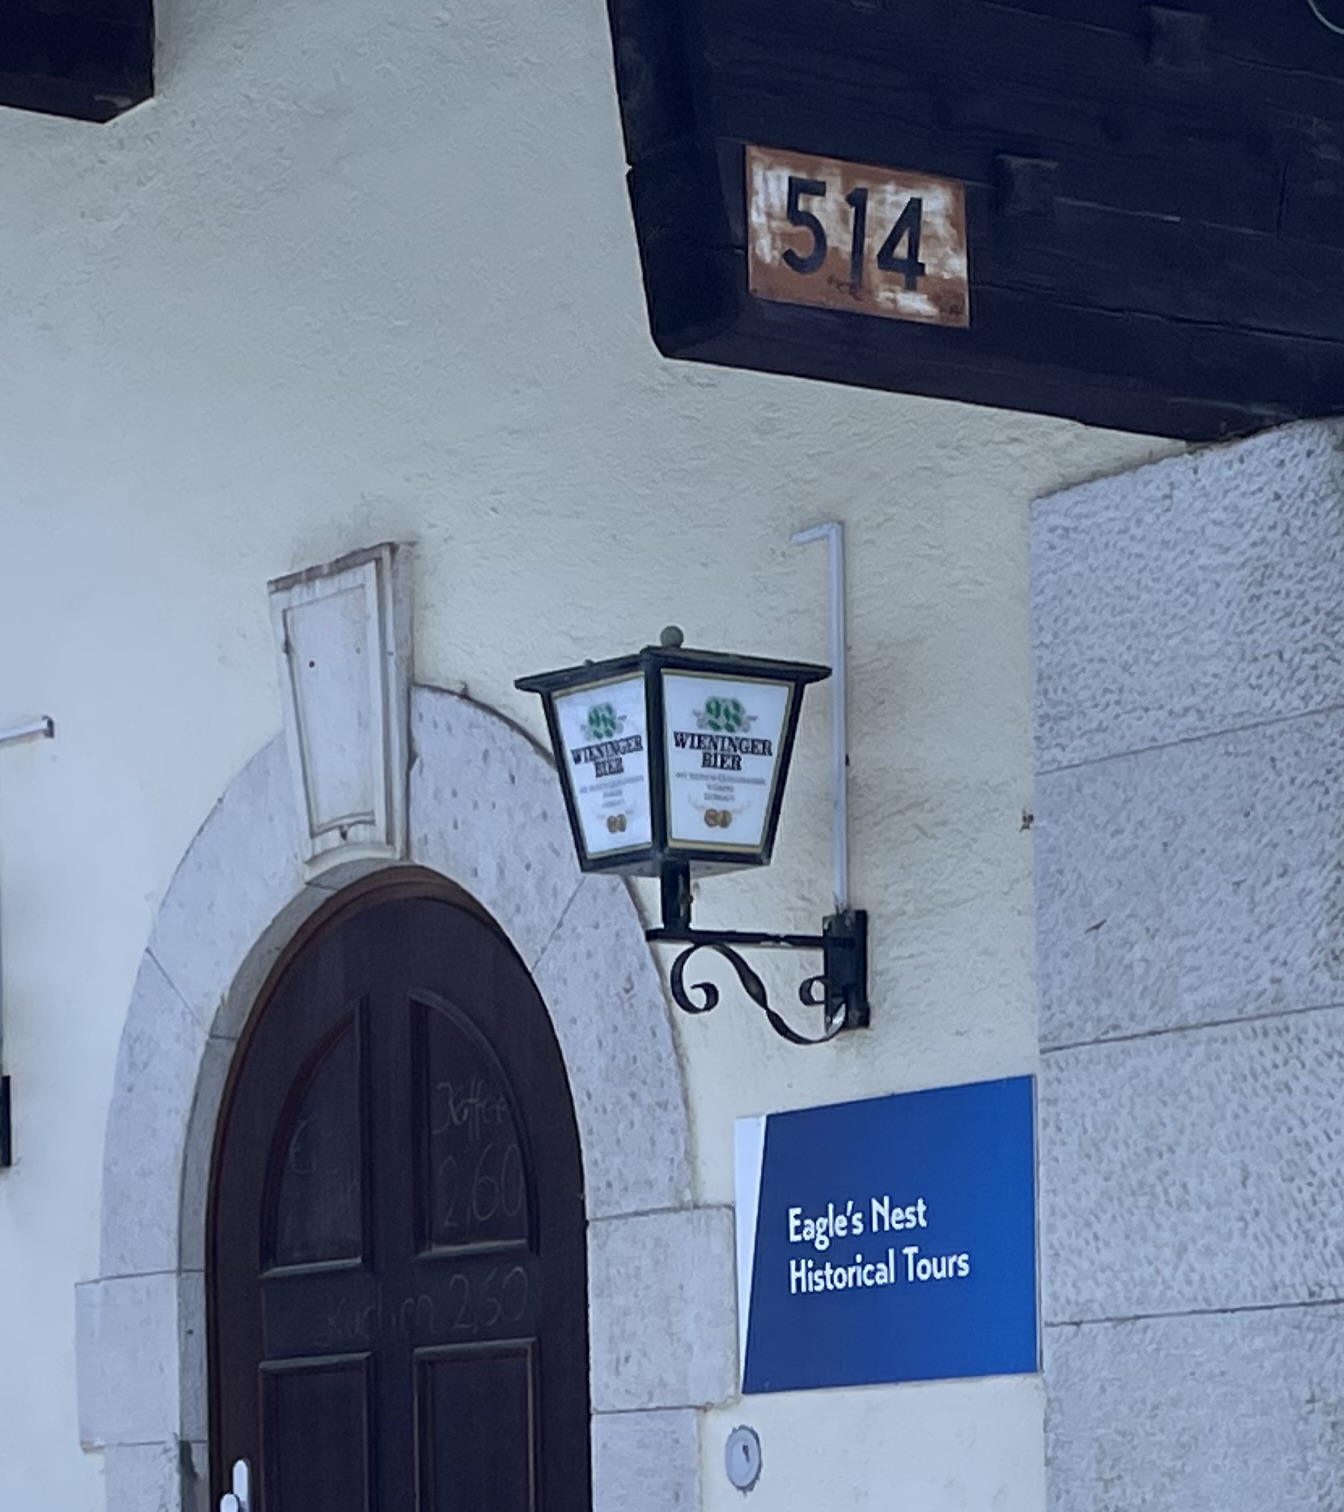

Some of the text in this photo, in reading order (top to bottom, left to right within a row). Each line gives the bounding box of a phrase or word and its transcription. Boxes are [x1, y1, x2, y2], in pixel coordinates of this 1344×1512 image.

[783, 176, 925, 291] 514
[673, 731, 773, 757] WIENINGER
[701, 752, 743, 771] BIER
[788, 1196, 927, 1250] Eagle's Nest
[789, 1246, 970, 1294] Historical Tours
